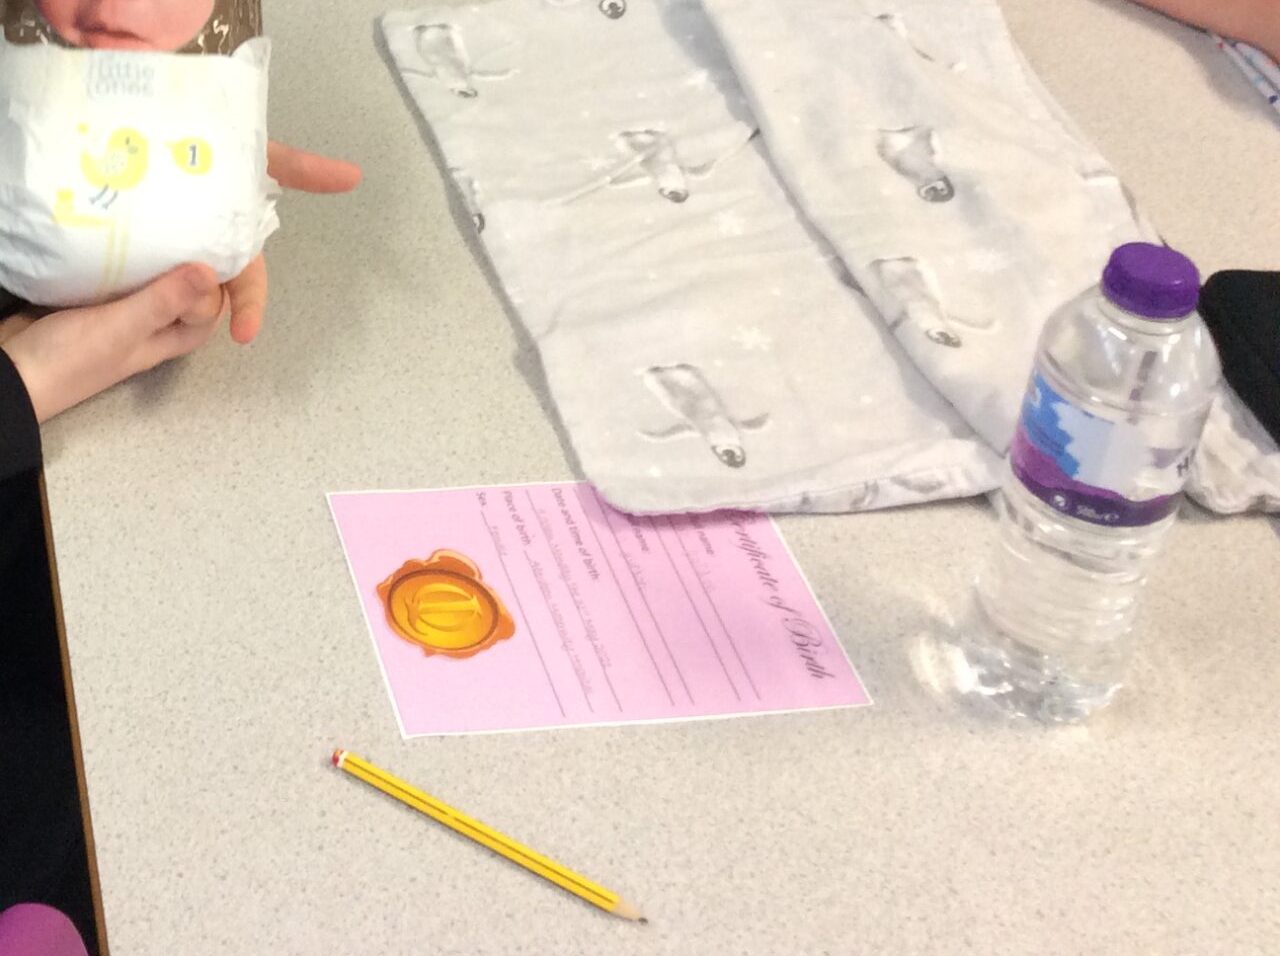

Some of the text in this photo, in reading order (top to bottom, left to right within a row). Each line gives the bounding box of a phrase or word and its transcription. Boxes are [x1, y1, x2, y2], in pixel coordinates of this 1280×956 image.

[187, 143, 199, 167] 1
[501, 490, 516, 511] Place
[510, 514, 524, 523] of
[552, 488, 602, 581] Date and time of birth:
[760, 595, 802, 619] of
[781, 617, 836, 680] Birth
